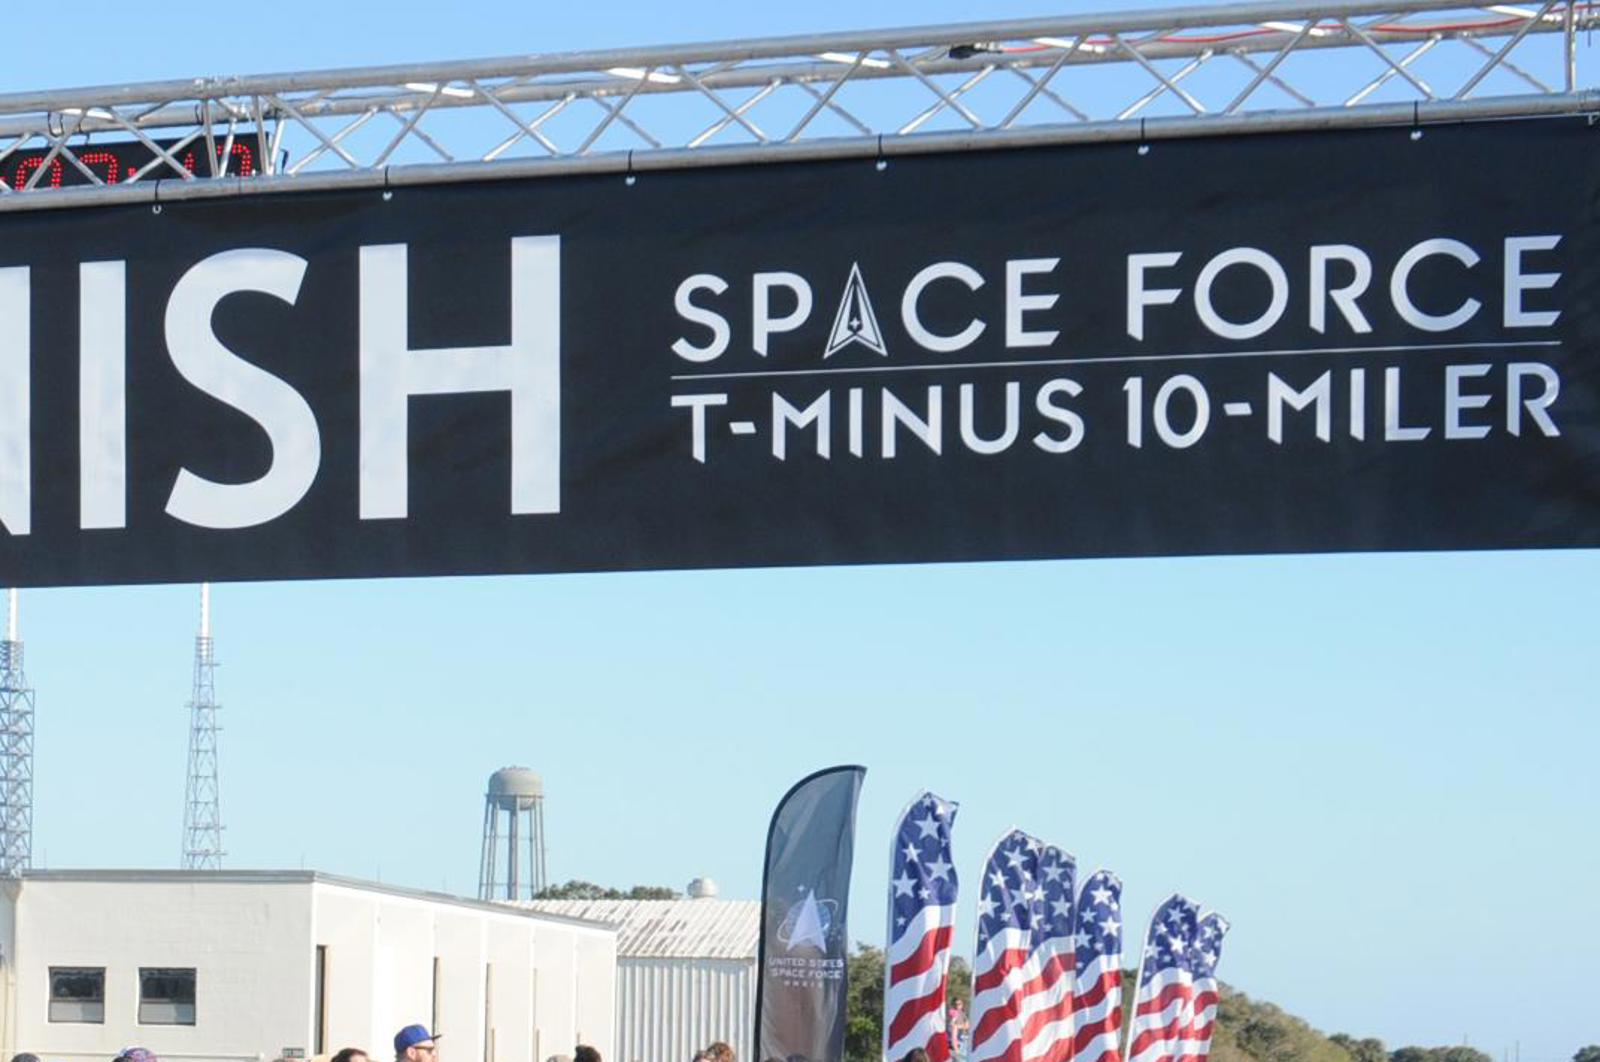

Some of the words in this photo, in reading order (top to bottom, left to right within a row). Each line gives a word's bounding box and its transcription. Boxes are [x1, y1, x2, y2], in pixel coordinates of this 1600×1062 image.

[671, 257, 1062, 362] SPACE
[1126, 234, 1563, 342] FORCE
[670, 377, 1086, 465] T-MINUS
[1122, 361, 1562, 449] 10-MILER
